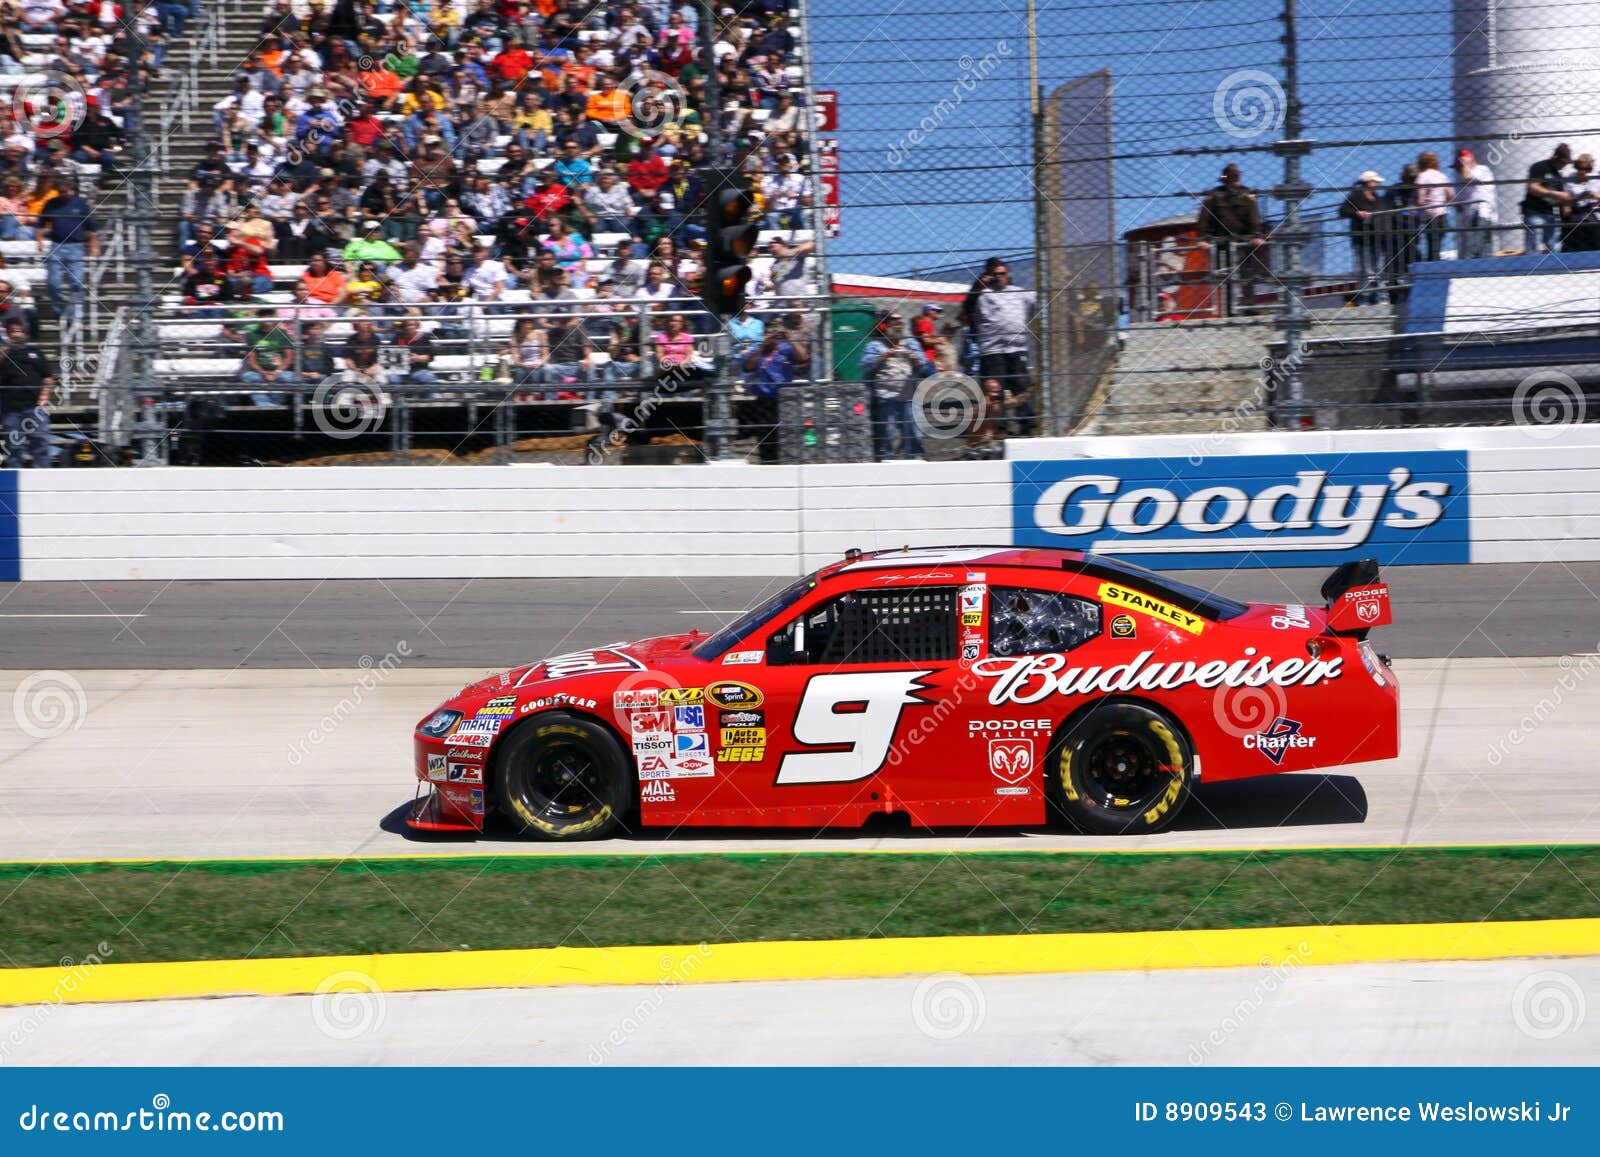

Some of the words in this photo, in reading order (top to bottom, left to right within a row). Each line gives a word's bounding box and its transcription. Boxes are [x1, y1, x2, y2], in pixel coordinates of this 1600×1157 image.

[1034, 467, 1449, 555] Goody's
[1345, 588, 1388, 599] DODGE
[1106, 586, 1197, 628] STANLEY
[971, 647, 1343, 706] Budweiser
[521, 692, 597, 713] GOODYEAR
[725, 693, 744, 701] Sprint
[479, 707, 515, 715] MOOG
[675, 706, 704, 727] USG
[460, 721, 500, 731] MAHLE
[633, 714, 670, 733] 3M
[773, 668, 945, 787] 9
[969, 719, 1052, 731] DODGE
[449, 735, 482, 743] COMP
[634, 741, 672, 750] TISSOT
[1243, 734, 1316, 749] Charter
[447, 748, 483, 761] Edelbrock
[718, 748, 765, 762] JEGS
[428, 757, 446, 770] WIX
[641, 756, 669, 771] EA
[450, 764, 481, 779] JE
[640, 770, 671, 778] SPORTS
[642, 780, 675, 796] MAC
